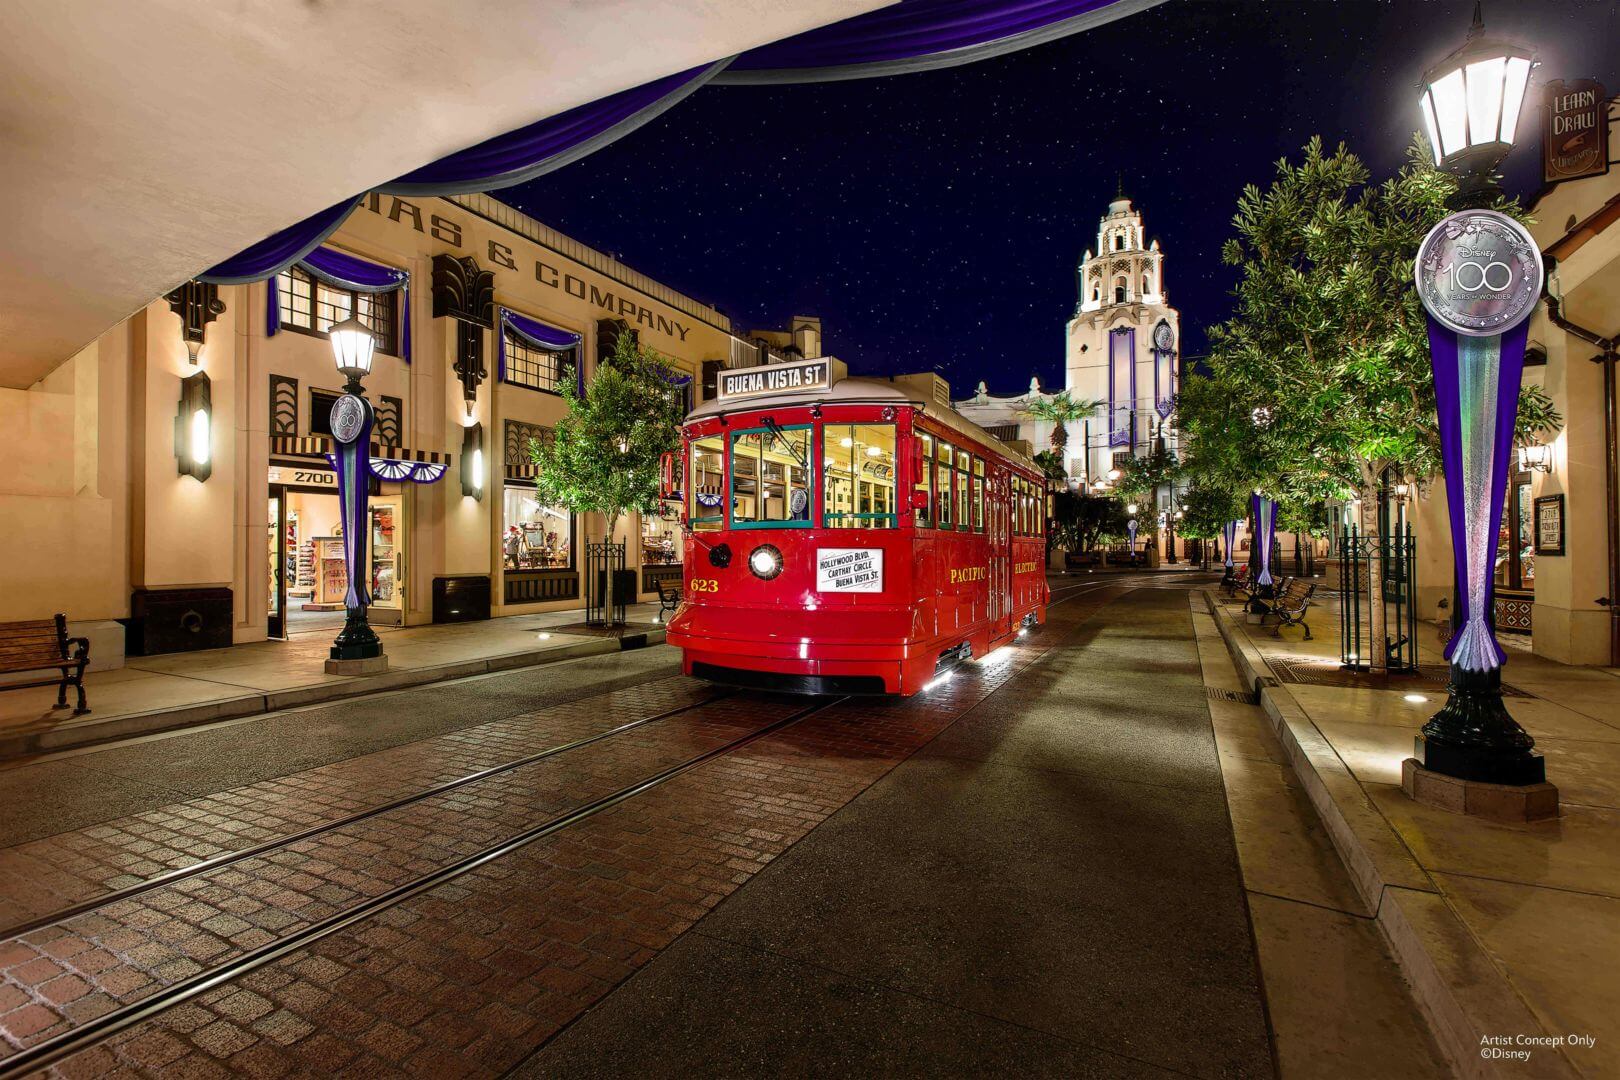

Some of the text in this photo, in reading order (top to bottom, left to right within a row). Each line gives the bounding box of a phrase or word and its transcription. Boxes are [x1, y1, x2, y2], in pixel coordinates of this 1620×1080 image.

[1554, 89, 1595, 114] LEARN
[1554, 111, 1595, 136] DRAW
[1442, 261, 1513, 292] 100
[487, 239, 519, 272] &
[535, 260, 691, 342] COMPANY
[727, 365, 821, 394] BUENA VISTA ST
[294, 471, 334, 484] 2700
[820, 551, 870, 570] HOLLYWOOD BLVD.
[828, 561, 873, 578] CARTHAY CIRCLE
[836, 577, 853, 588] BUENA
[855, 573, 870, 583] VISTA
[950, 561, 1038, 584] PACIFIC ELECTRIC
[690, 578, 719, 593] 623
